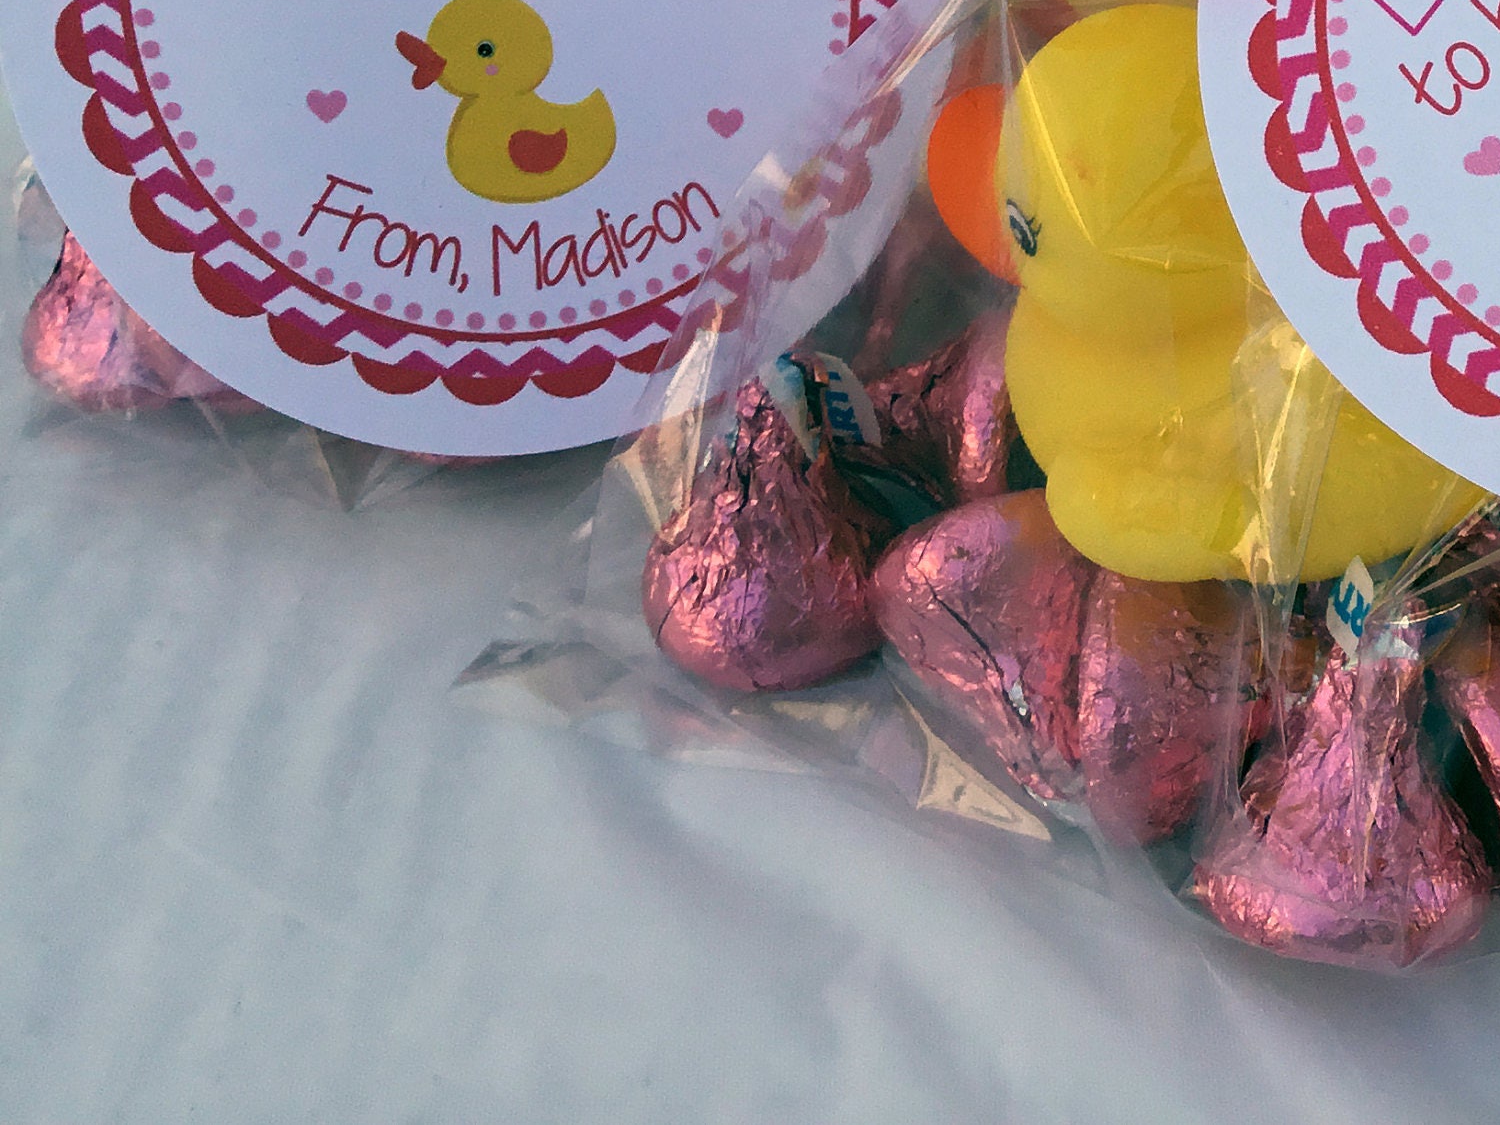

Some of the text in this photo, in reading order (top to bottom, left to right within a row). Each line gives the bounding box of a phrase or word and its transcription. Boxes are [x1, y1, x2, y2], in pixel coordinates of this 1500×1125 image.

[1398, 40, 1492, 117] to
[298, 173, 720, 296] From, Madison
